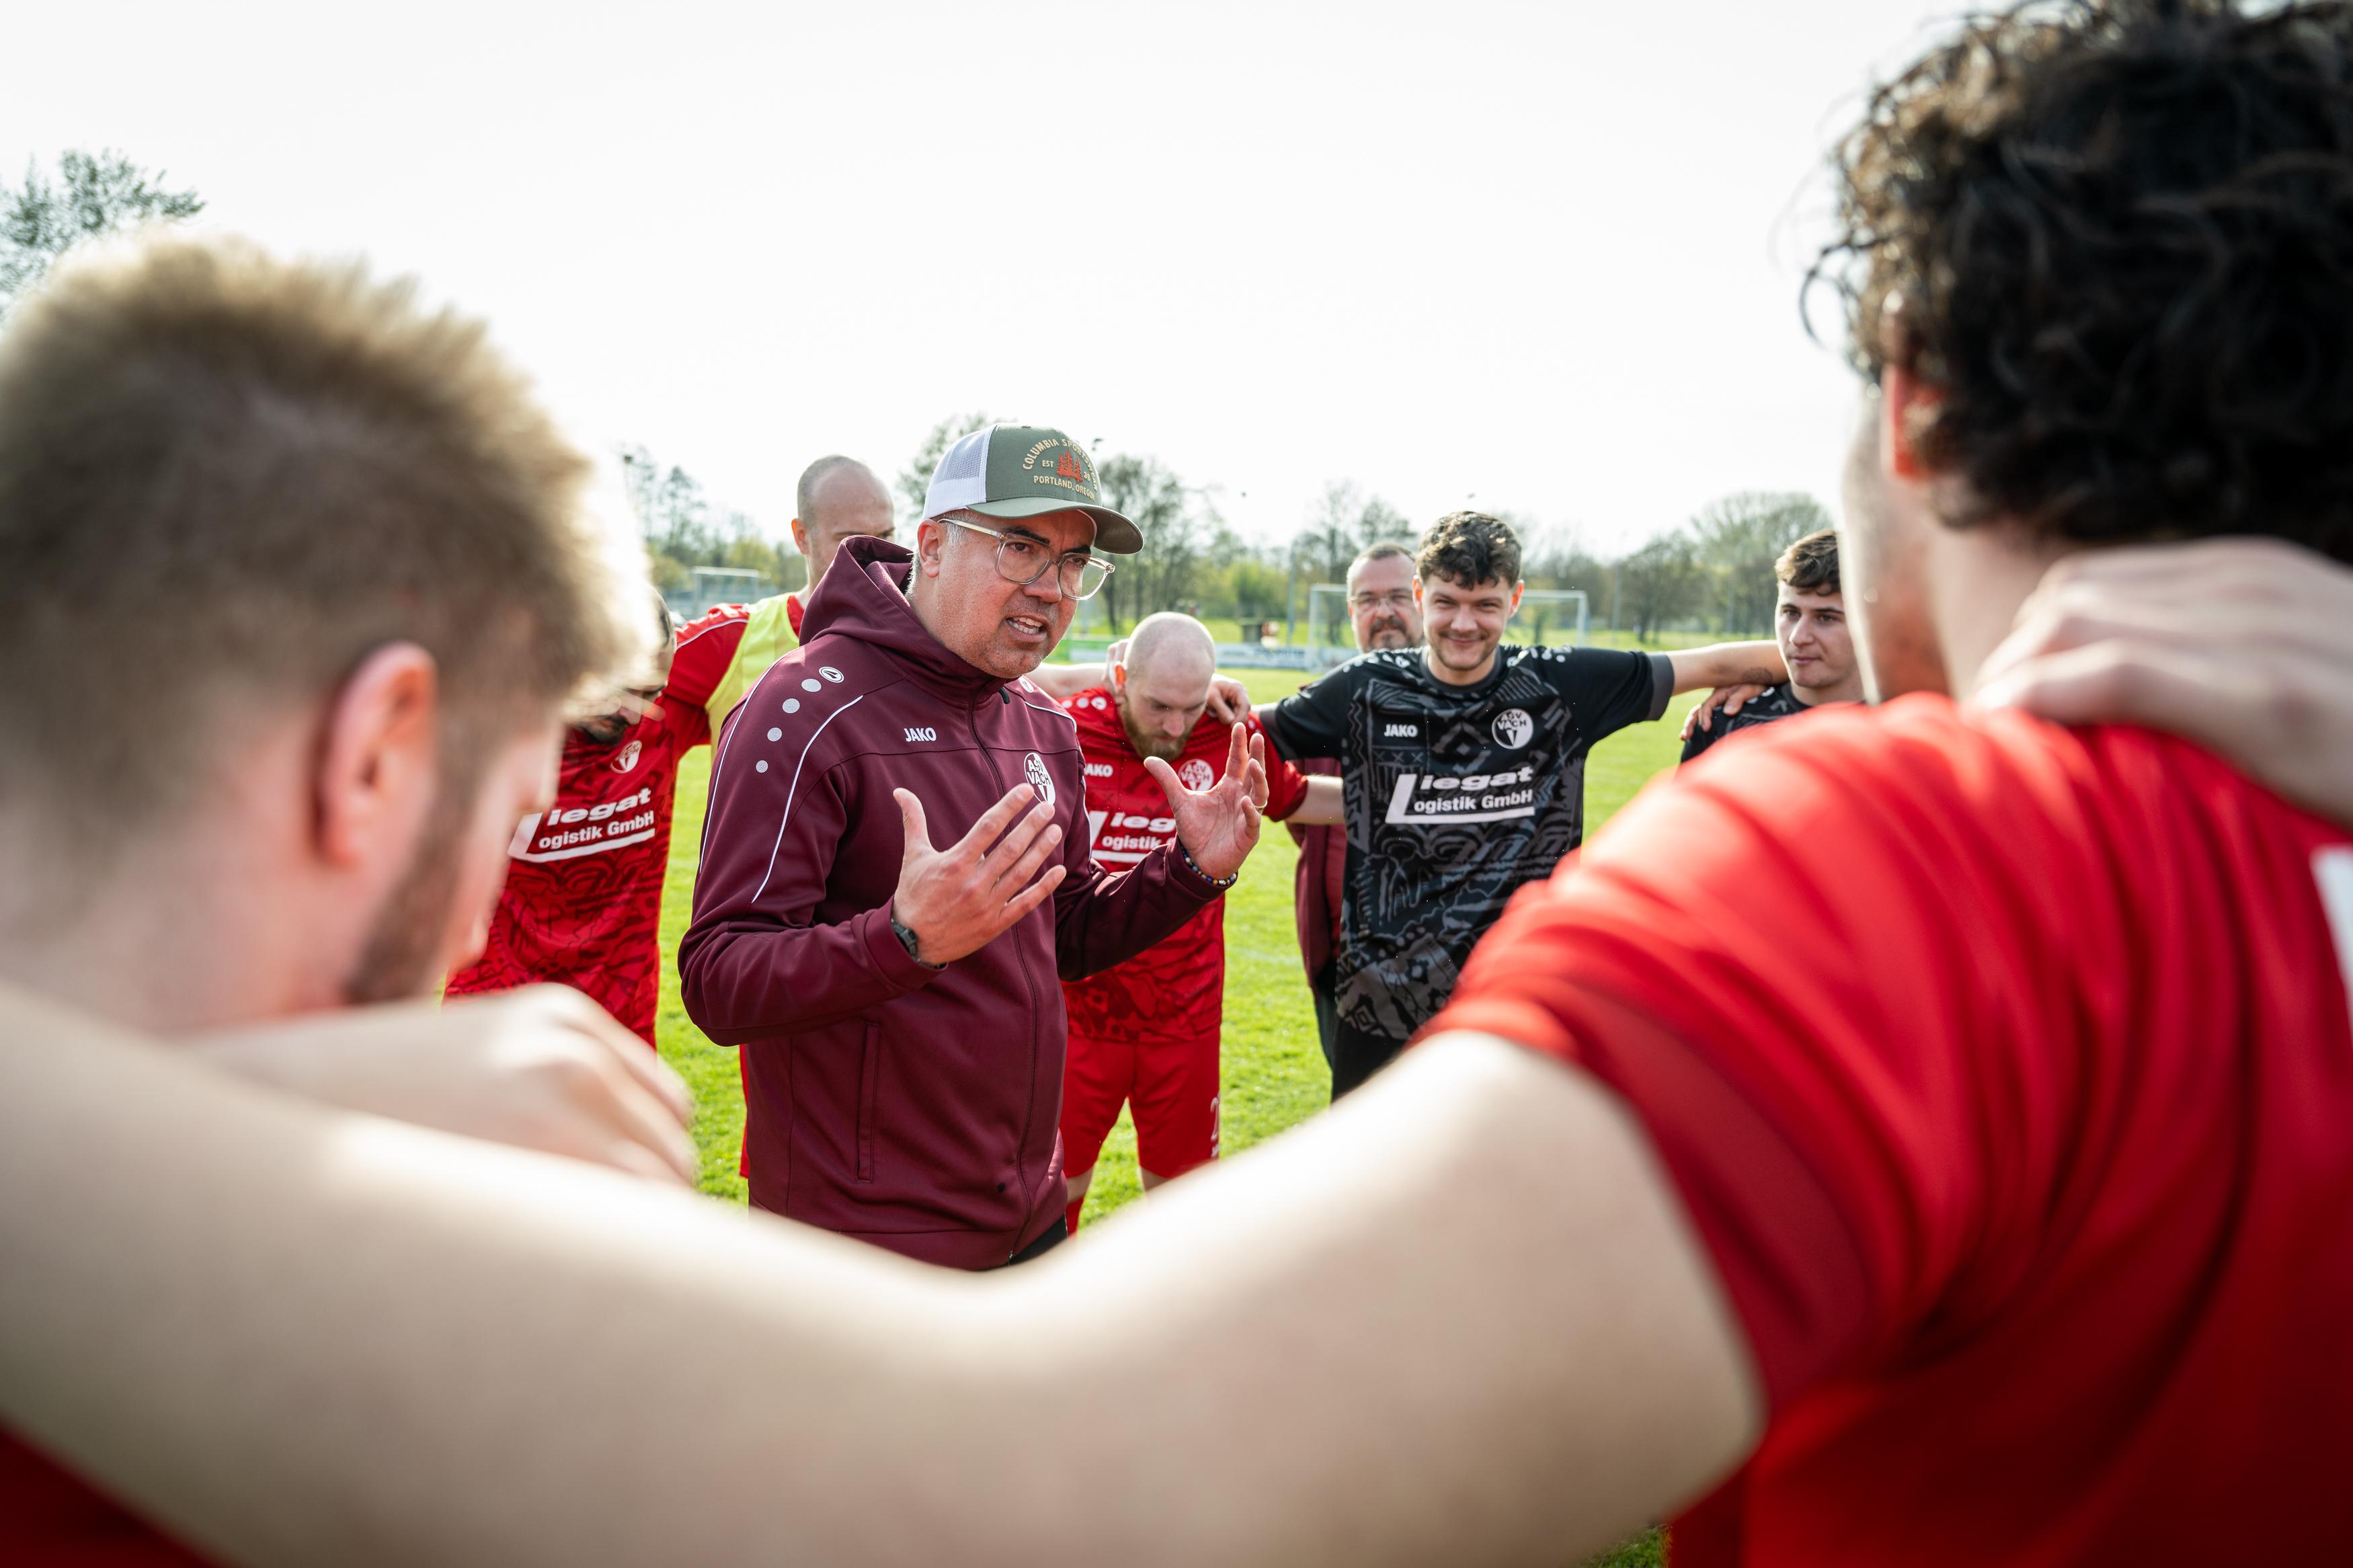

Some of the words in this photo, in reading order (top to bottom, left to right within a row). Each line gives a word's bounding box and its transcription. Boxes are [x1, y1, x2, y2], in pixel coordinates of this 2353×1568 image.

[1023, 438, 1060, 470] COLUMBIA
[1042, 460, 1054, 468] EST
[1076, 484, 1095, 502] OREGON
[1501, 712, 1522, 721] ASV
[1384, 725, 1418, 738] JAKO
[1497, 720, 1527, 730] VACH
[903, 727, 936, 742] JAKO
[1085, 764, 1113, 778] AKO
[1027, 772, 1051, 785] VACH
[1481, 789, 1533, 809] GmbH
[607, 811, 654, 836] GmbH
